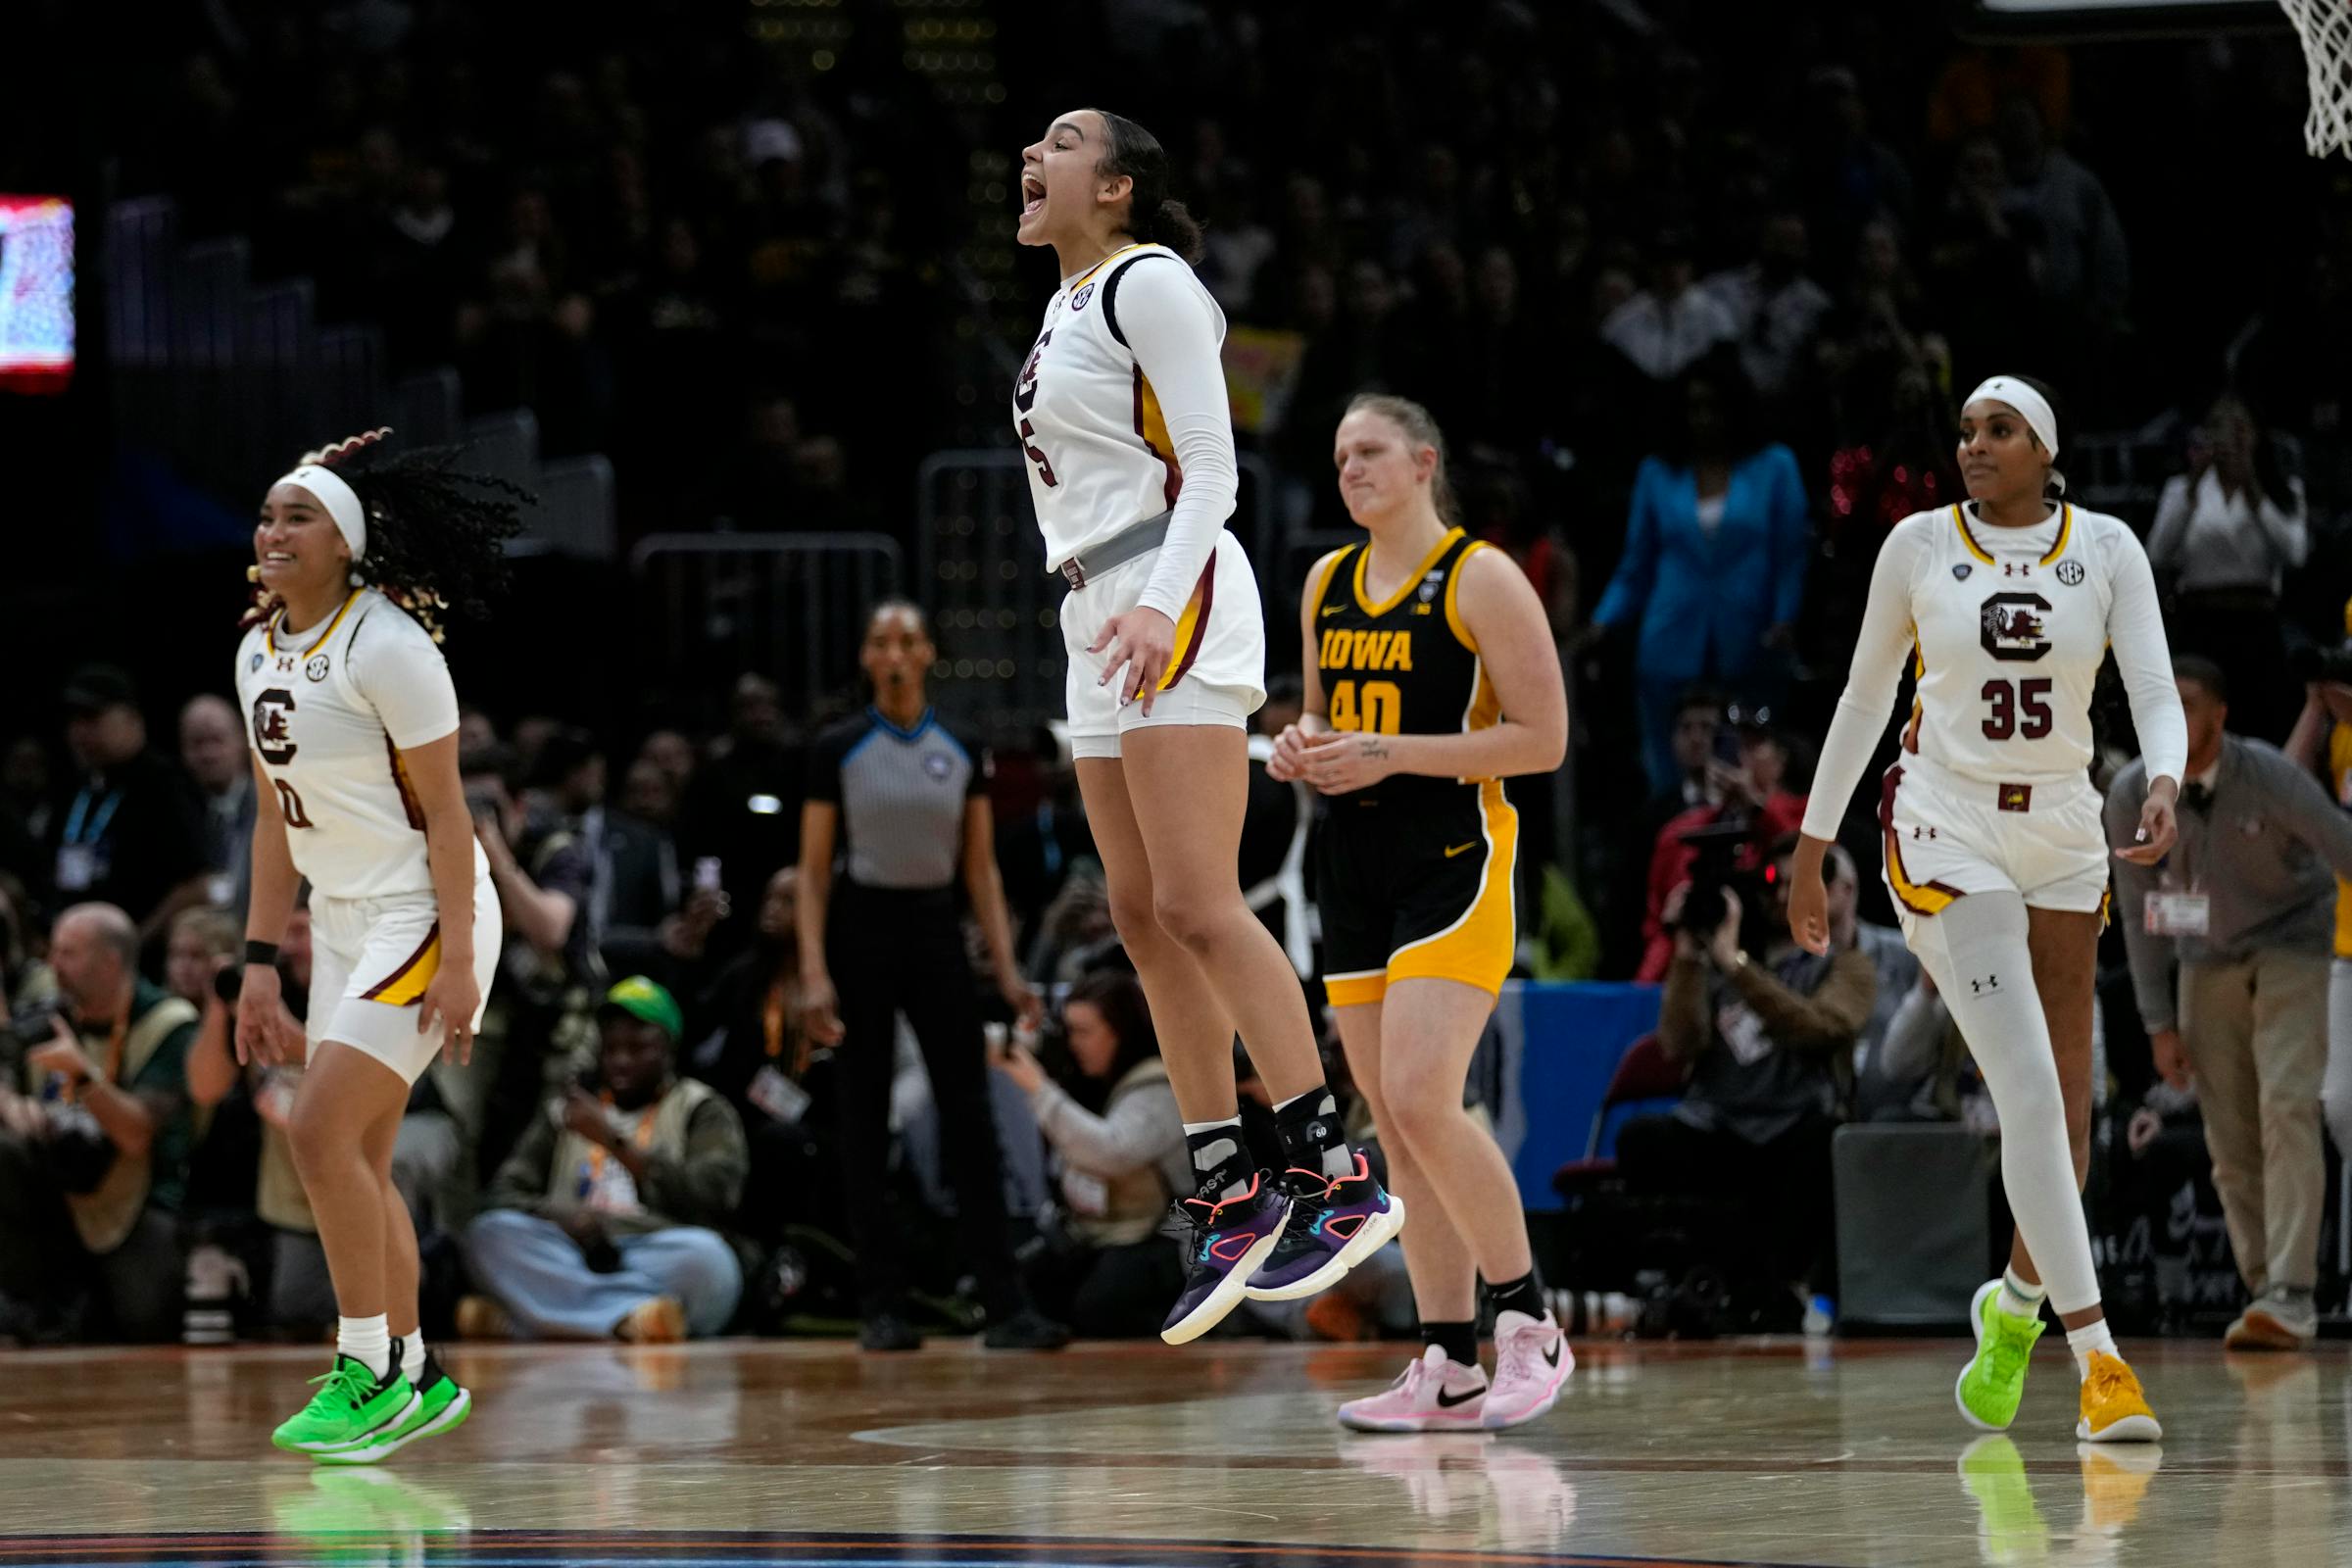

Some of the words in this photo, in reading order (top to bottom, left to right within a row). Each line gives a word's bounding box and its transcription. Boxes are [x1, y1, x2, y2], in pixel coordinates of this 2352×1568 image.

[1019, 417, 1058, 488] 5
[2056, 560, 2084, 586] SEC
[1319, 628, 1413, 672] IOWA
[1330, 679, 1401, 736] 40
[1981, 678, 2053, 742] 35
[273, 778, 315, 829] 0
